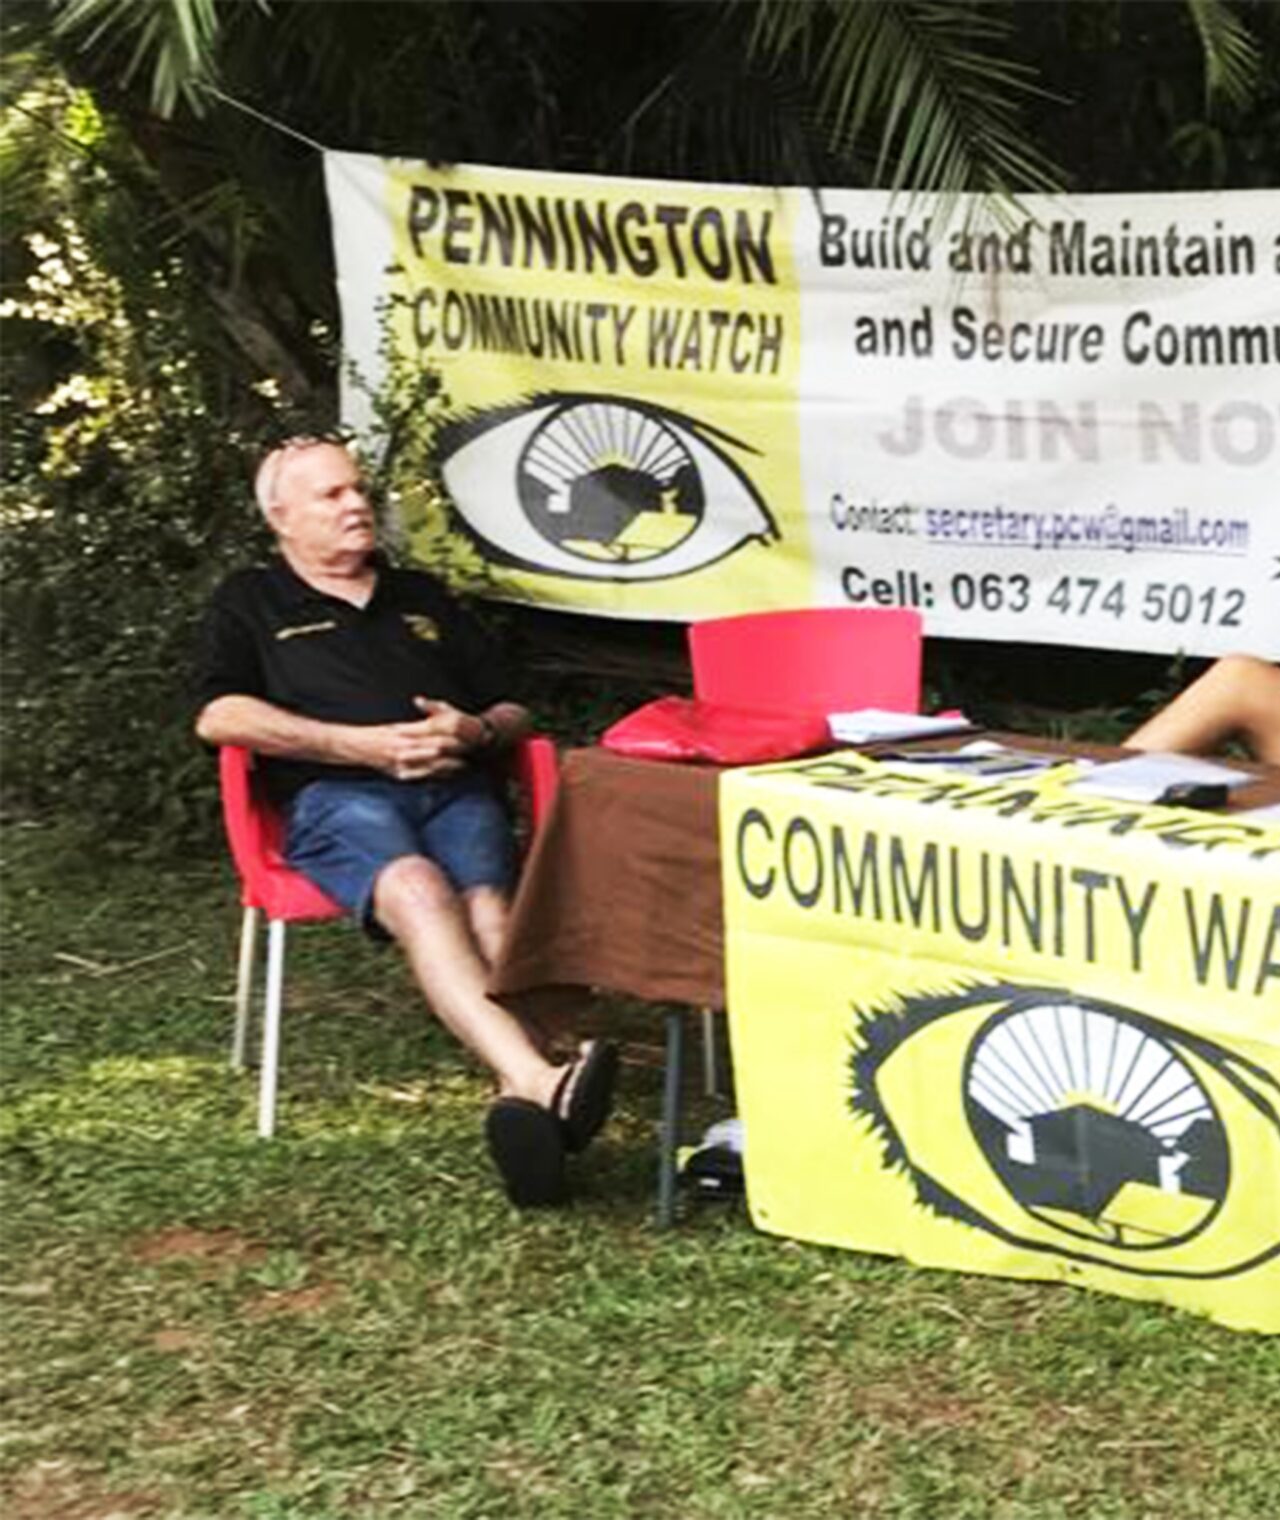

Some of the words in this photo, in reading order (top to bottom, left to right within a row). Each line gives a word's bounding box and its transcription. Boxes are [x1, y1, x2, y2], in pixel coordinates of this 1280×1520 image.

[408, 184, 778, 285] PENNINGTON
[819, 213, 932, 271] Build
[948, 221, 1034, 275] and
[1049, 218, 1255, 277] Maintain
[413, 286, 636, 366] COMMUNITY
[647, 307, 783, 375] WATCH
[854, 305, 933, 357] and
[951, 306, 1105, 363] Secure
[877, 395, 1101, 463] JOIN
[840, 565, 935, 609] Cell:
[950, 572, 1031, 614] 063
[1046, 575, 1127, 619] 474
[1141, 581, 1248, 628] 5012
[736, 807, 1159, 972] COMMUNITY
